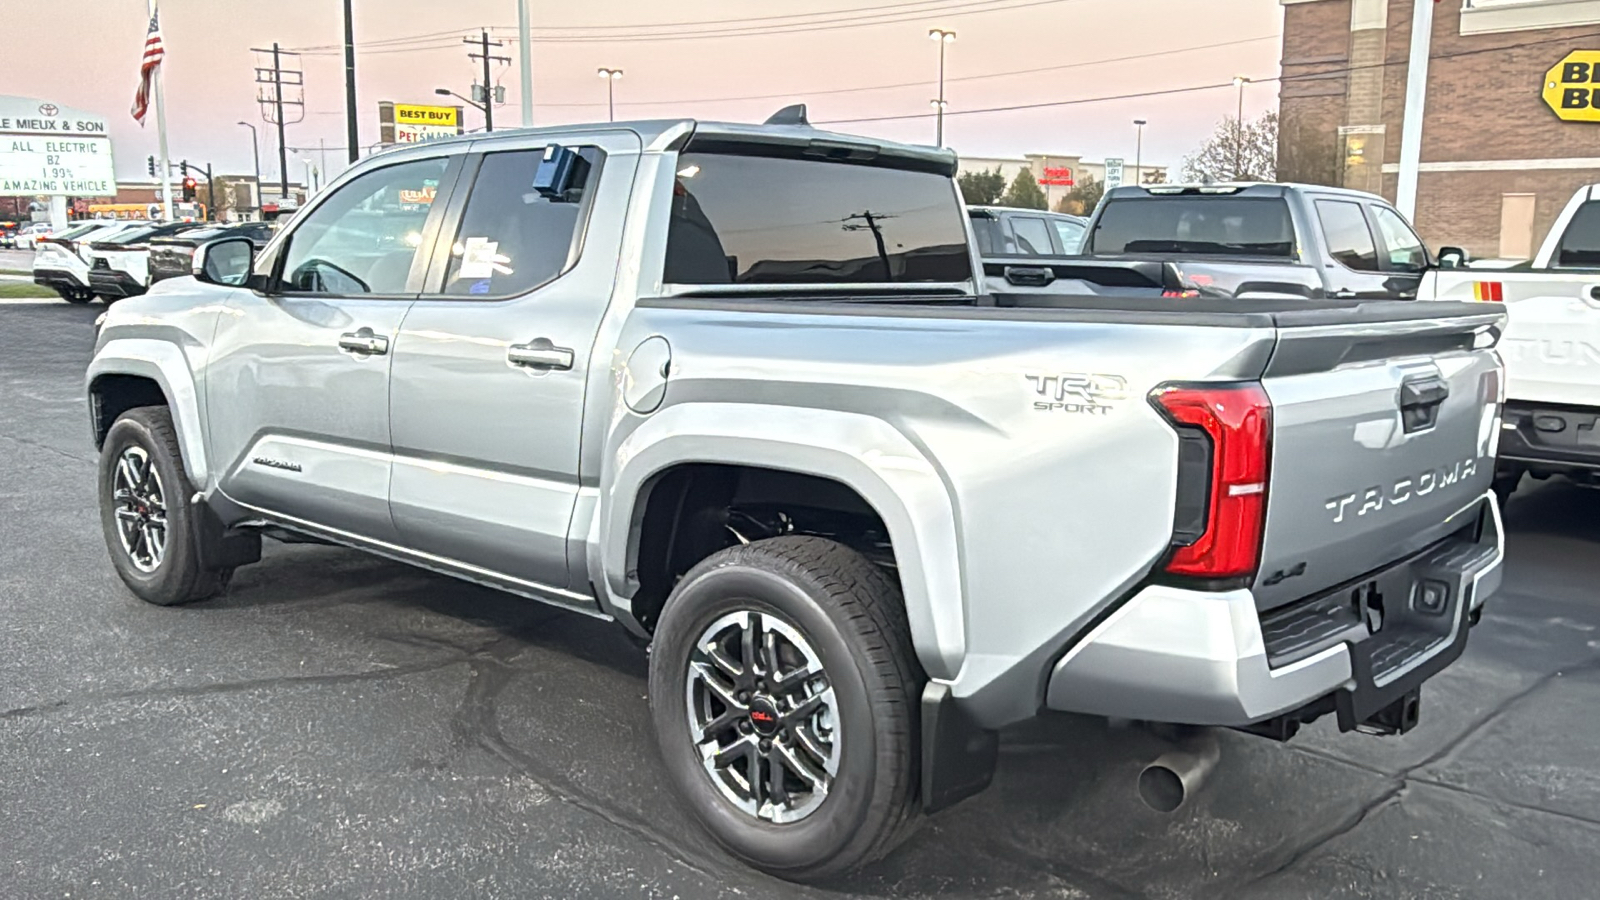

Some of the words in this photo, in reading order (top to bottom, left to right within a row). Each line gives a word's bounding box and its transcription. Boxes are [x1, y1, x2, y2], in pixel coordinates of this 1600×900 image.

[400, 110, 426, 119] BEST
[428, 111, 451, 120] BUY
[16, 119, 56, 131] MIEUX
[62, 121, 70, 131] &
[76, 121, 104, 132] SON
[12, 141, 34, 152] ALL
[46, 142, 97, 153] ELECTRIC
[47, 155, 60, 165] BZ
[3, 181, 57, 191] AMAZING
[63, 181, 108, 191] VEHICLE
[1024, 372, 1128, 404] TRD
[1033, 401, 1113, 415] SPORT
[1325, 459, 1477, 523] TACOMA
